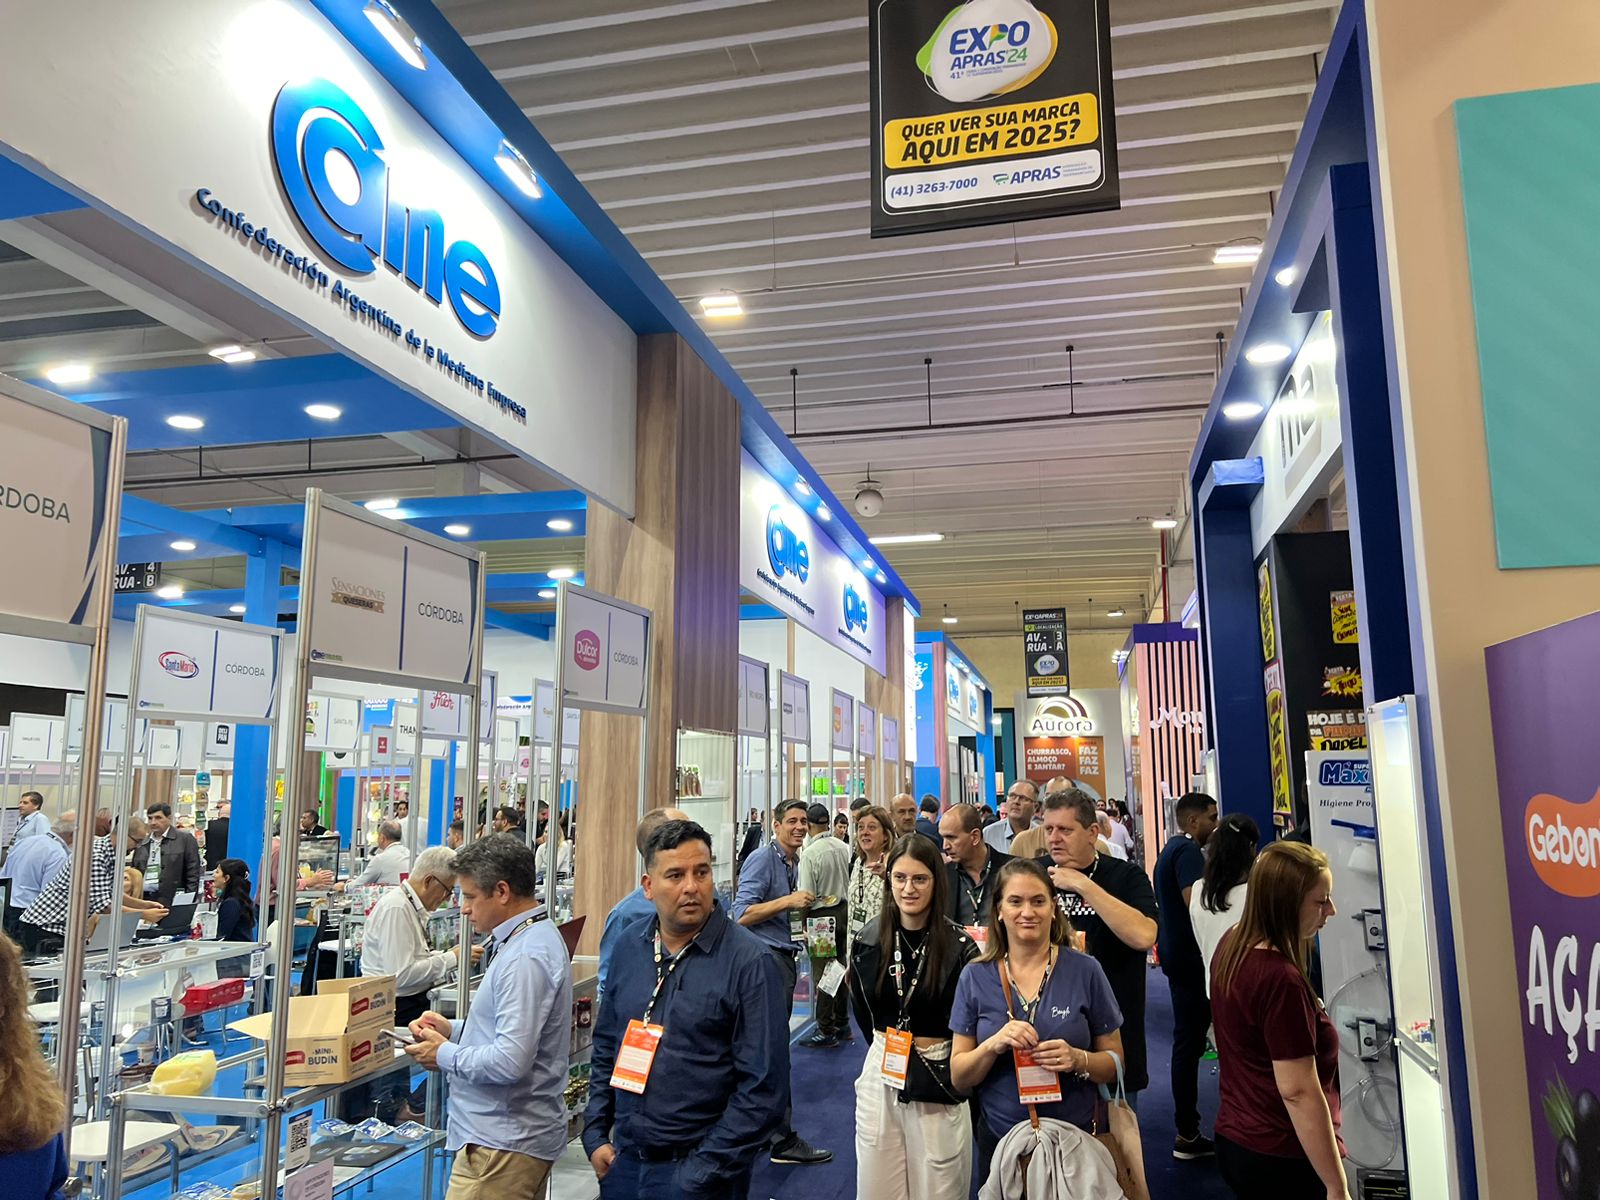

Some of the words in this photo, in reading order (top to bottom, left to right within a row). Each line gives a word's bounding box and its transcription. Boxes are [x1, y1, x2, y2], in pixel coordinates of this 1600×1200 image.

[949, 20, 1030, 55] EXPO
[901, 121, 945, 141] QUER
[950, 115, 981, 132] VER
[986, 110, 1018, 128] SUA
[1022, 101, 1080, 123] MARCA
[901, 136, 960, 164] AQUI
[965, 129, 999, 154] EM
[1004, 119, 1081, 149] 2025?
[1010, 165, 1062, 185] APRAS
[890, 181, 914, 199] (41)
[916, 177, 978, 195] 3263-7000
[196, 188, 329, 288] Confederación
[331, 279, 402, 337] Argentina
[405, 329, 421, 349] de
[423, 339, 435, 359] la
[437, 348, 485, 391] Mediana
[487, 381, 527, 418] Empresa
[147, 562, 155, 572] 4
[146, 574, 155, 587] B
[418, 601, 464, 624] CÓRDOBA
[1056, 631, 1063, 640] 3
[1027, 643, 1047, 653] RUA
[1056, 642, 1064, 651] A
[613, 649, 639, 666] CÓRDOBA
[225, 662, 265, 677] CÓRDOBA
[1307, 713, 1343, 726] HOJE
[1346, 710, 1355, 724] É
[1032, 719, 1093, 731] Aurora
[217, 735, 228, 744] PAN
[1027, 748, 1072, 756] CHURRASCO,
[1079, 746, 1099, 755] FAZ
[1034, 763, 1065, 771] JANTAR?
[1079, 756, 1099, 765] FAZ
[1322, 763, 1369, 784] Max
[1320, 800, 1353, 808] Higiene
[1356, 800, 1372, 808] Pro
[308, 1055, 338, 1066] BUDIN
